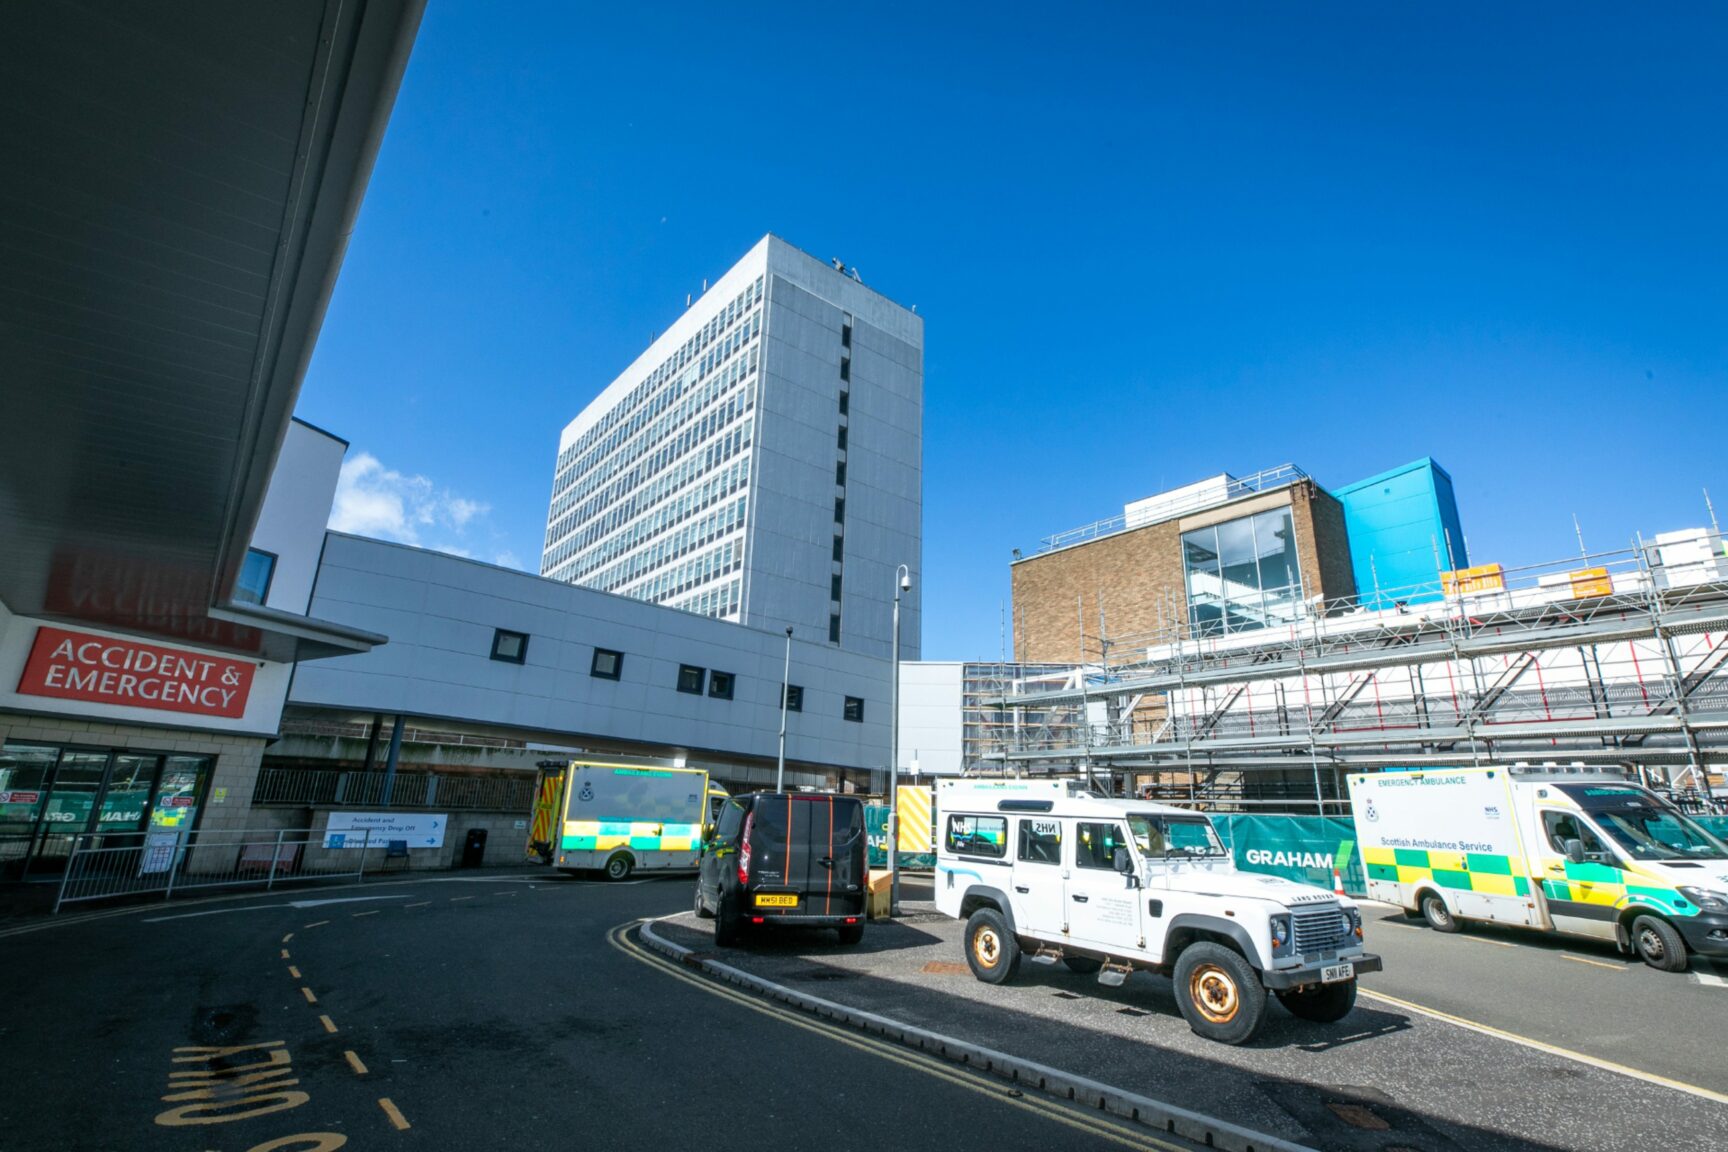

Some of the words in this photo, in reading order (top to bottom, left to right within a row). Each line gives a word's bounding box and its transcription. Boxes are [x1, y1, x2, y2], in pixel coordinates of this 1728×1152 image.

[51, 639, 216, 682] ACCIDENT
[221, 665, 243, 686] &
[44, 664, 237, 709] EMERGENCY
[1378, 778, 1418, 787] EMERGENCY
[1420, 776, 1467, 786] AMBULANCE
[352, 816, 381, 824] Accident
[952, 819, 972, 833] NHS
[1381, 837, 1411, 848] Scottish
[1412, 838, 1457, 850] Ambulance
[1458, 841, 1493, 852] Service
[1246, 849, 1334, 869] GRAHAM
[1312, 893, 1335, 901] ROVER
[154, 1040, 310, 1126] ONLY
